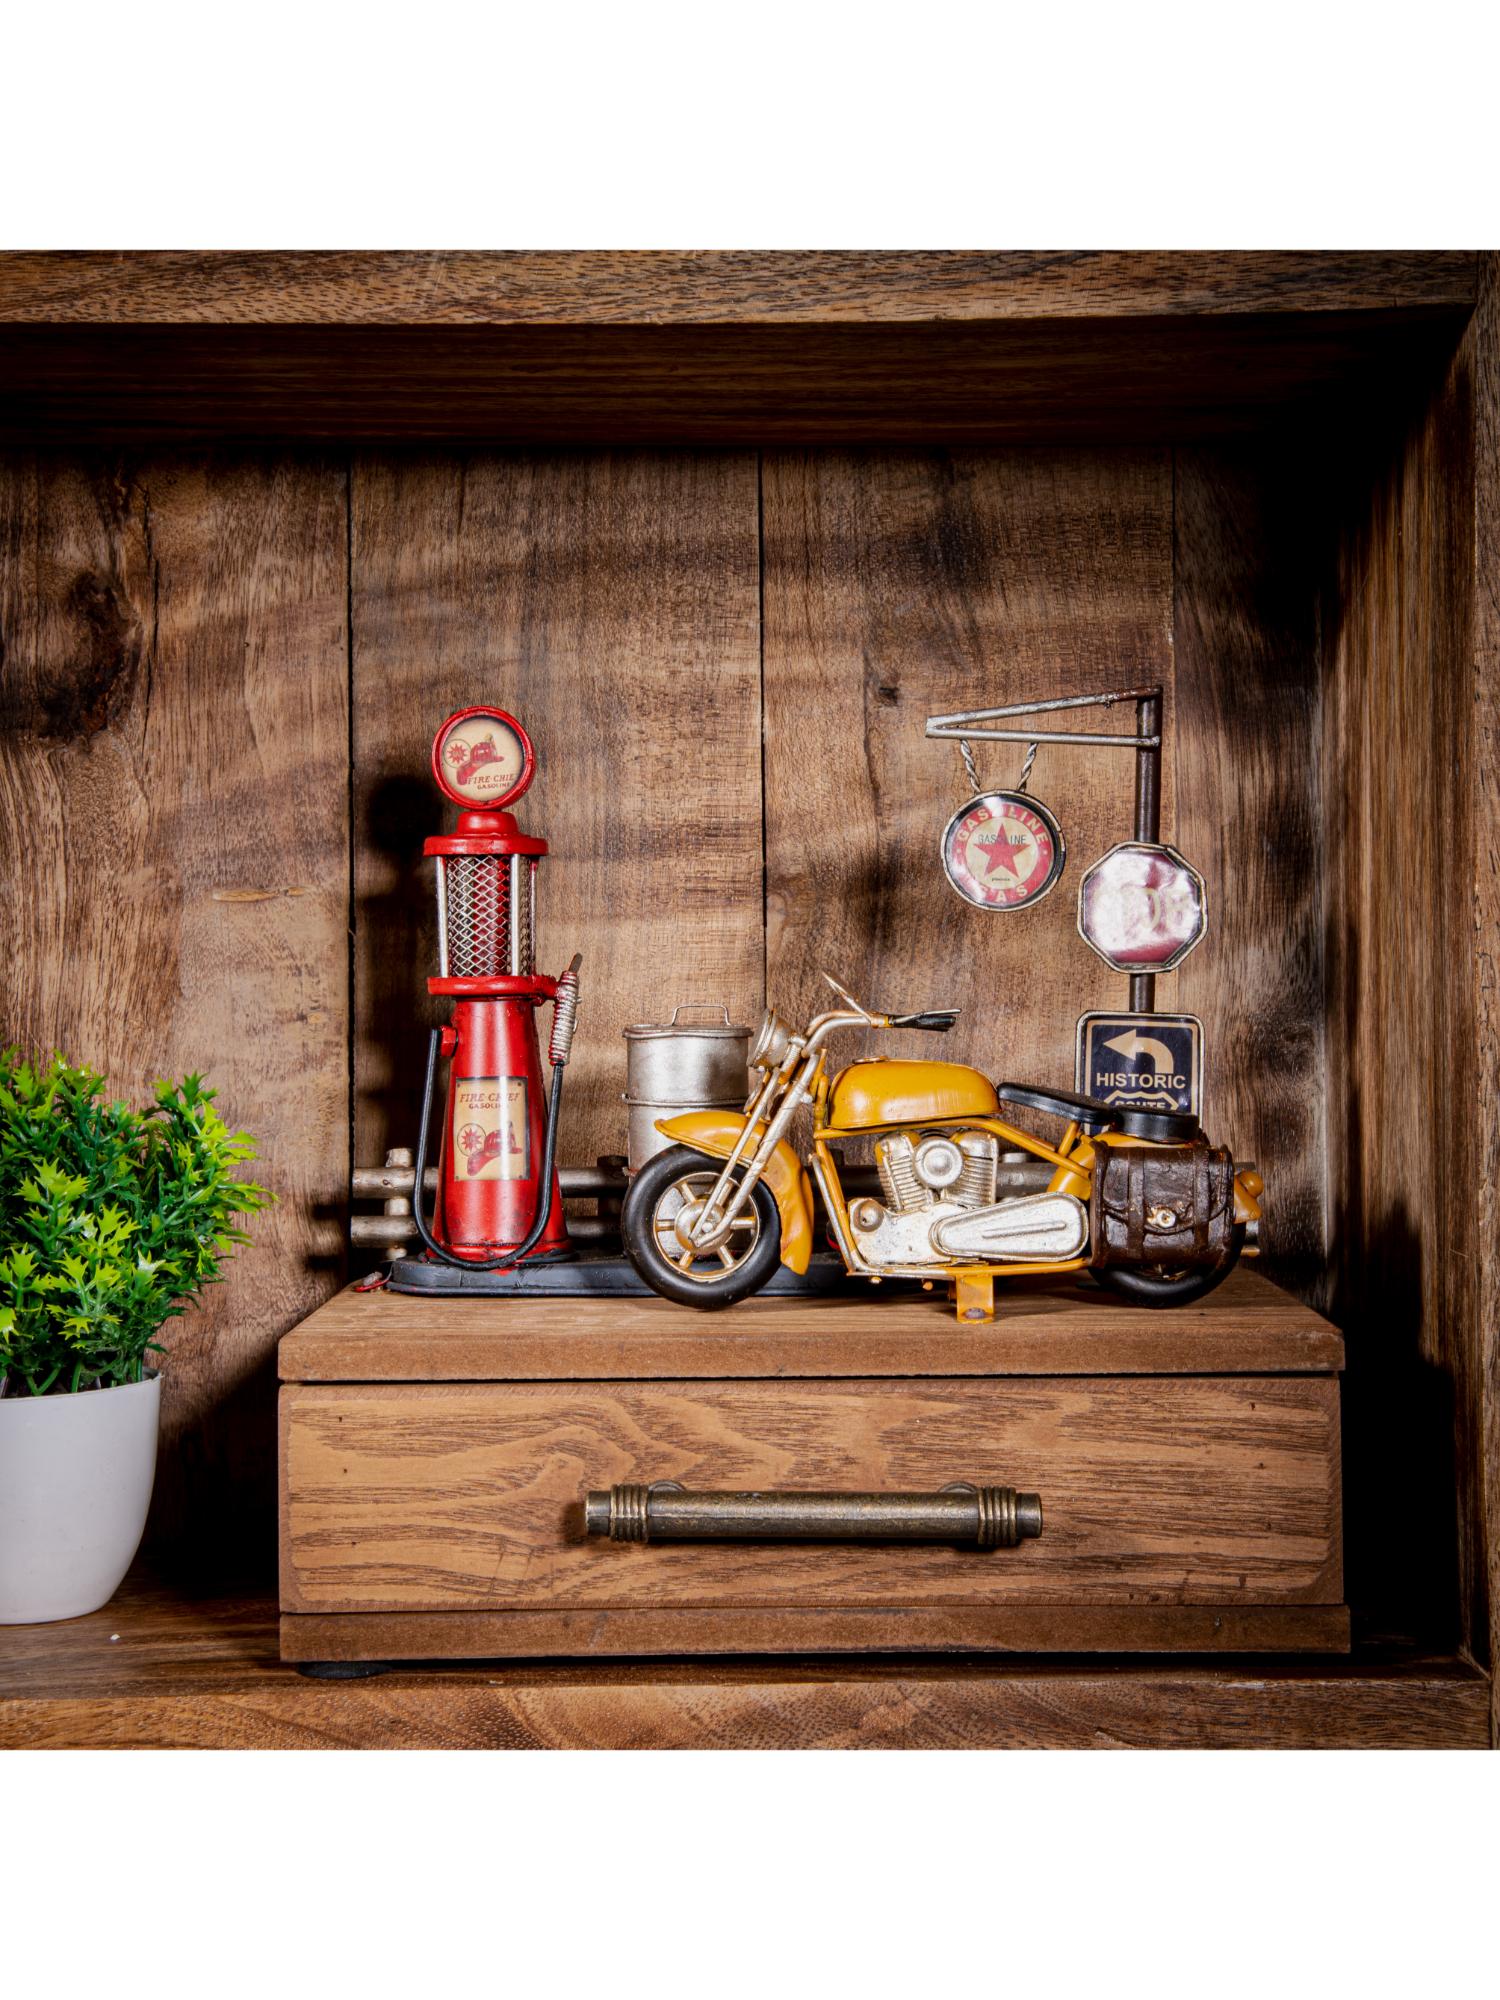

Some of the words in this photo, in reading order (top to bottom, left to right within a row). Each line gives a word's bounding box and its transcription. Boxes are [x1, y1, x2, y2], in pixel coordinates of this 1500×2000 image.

[468, 776, 490, 784] FIRE
[957, 805, 1049, 843] GASLINE
[978, 834, 1027, 845] GASINE
[1096, 1072, 1186, 1089] HISTORIC
[460, 1094, 485, 1103] FIRE
[488, 1093, 519, 1102] CHEF
